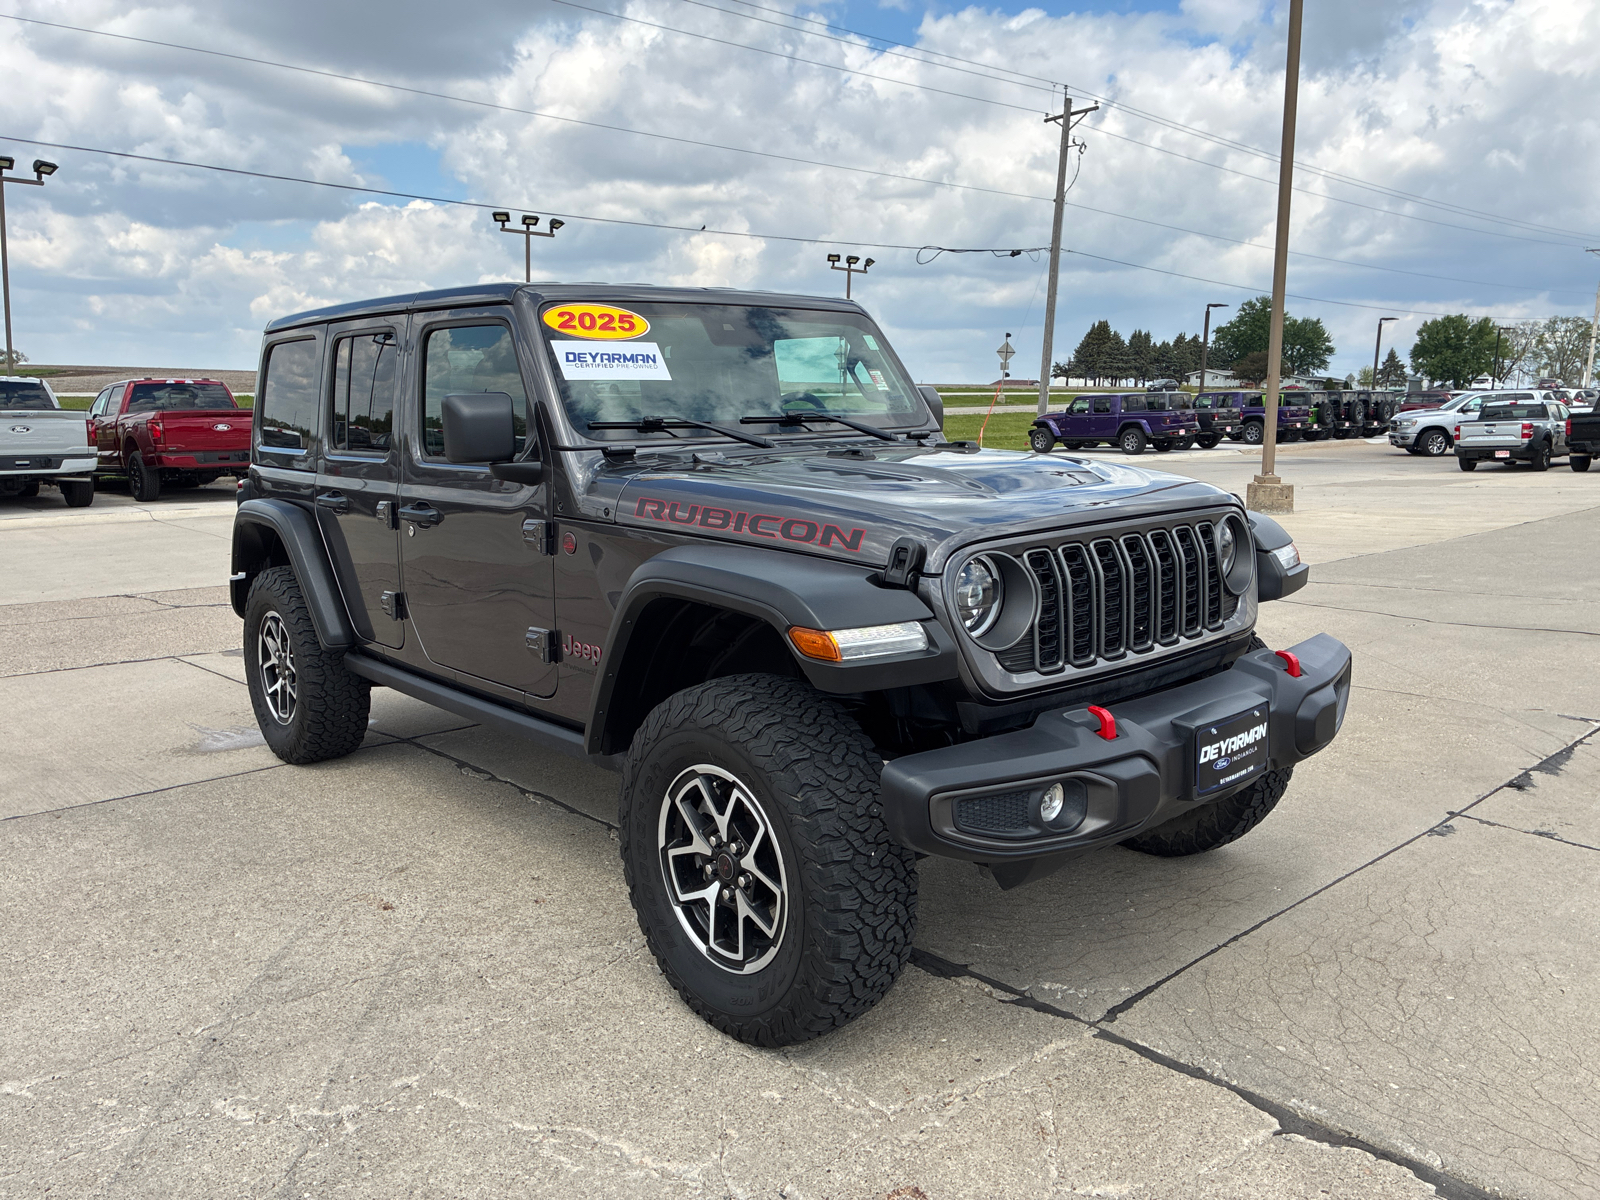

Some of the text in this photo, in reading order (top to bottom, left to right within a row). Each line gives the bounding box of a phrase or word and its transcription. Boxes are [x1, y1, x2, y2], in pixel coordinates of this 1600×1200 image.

[557, 311, 636, 332] 2025
[565, 352, 657, 364] DEYARMAN
[634, 496, 867, 552] RUBICON
[562, 634, 602, 667] Jeep
[1199, 722, 1267, 764] DEYARMAN
[1231, 745, 1258, 762] INDIANOLA
